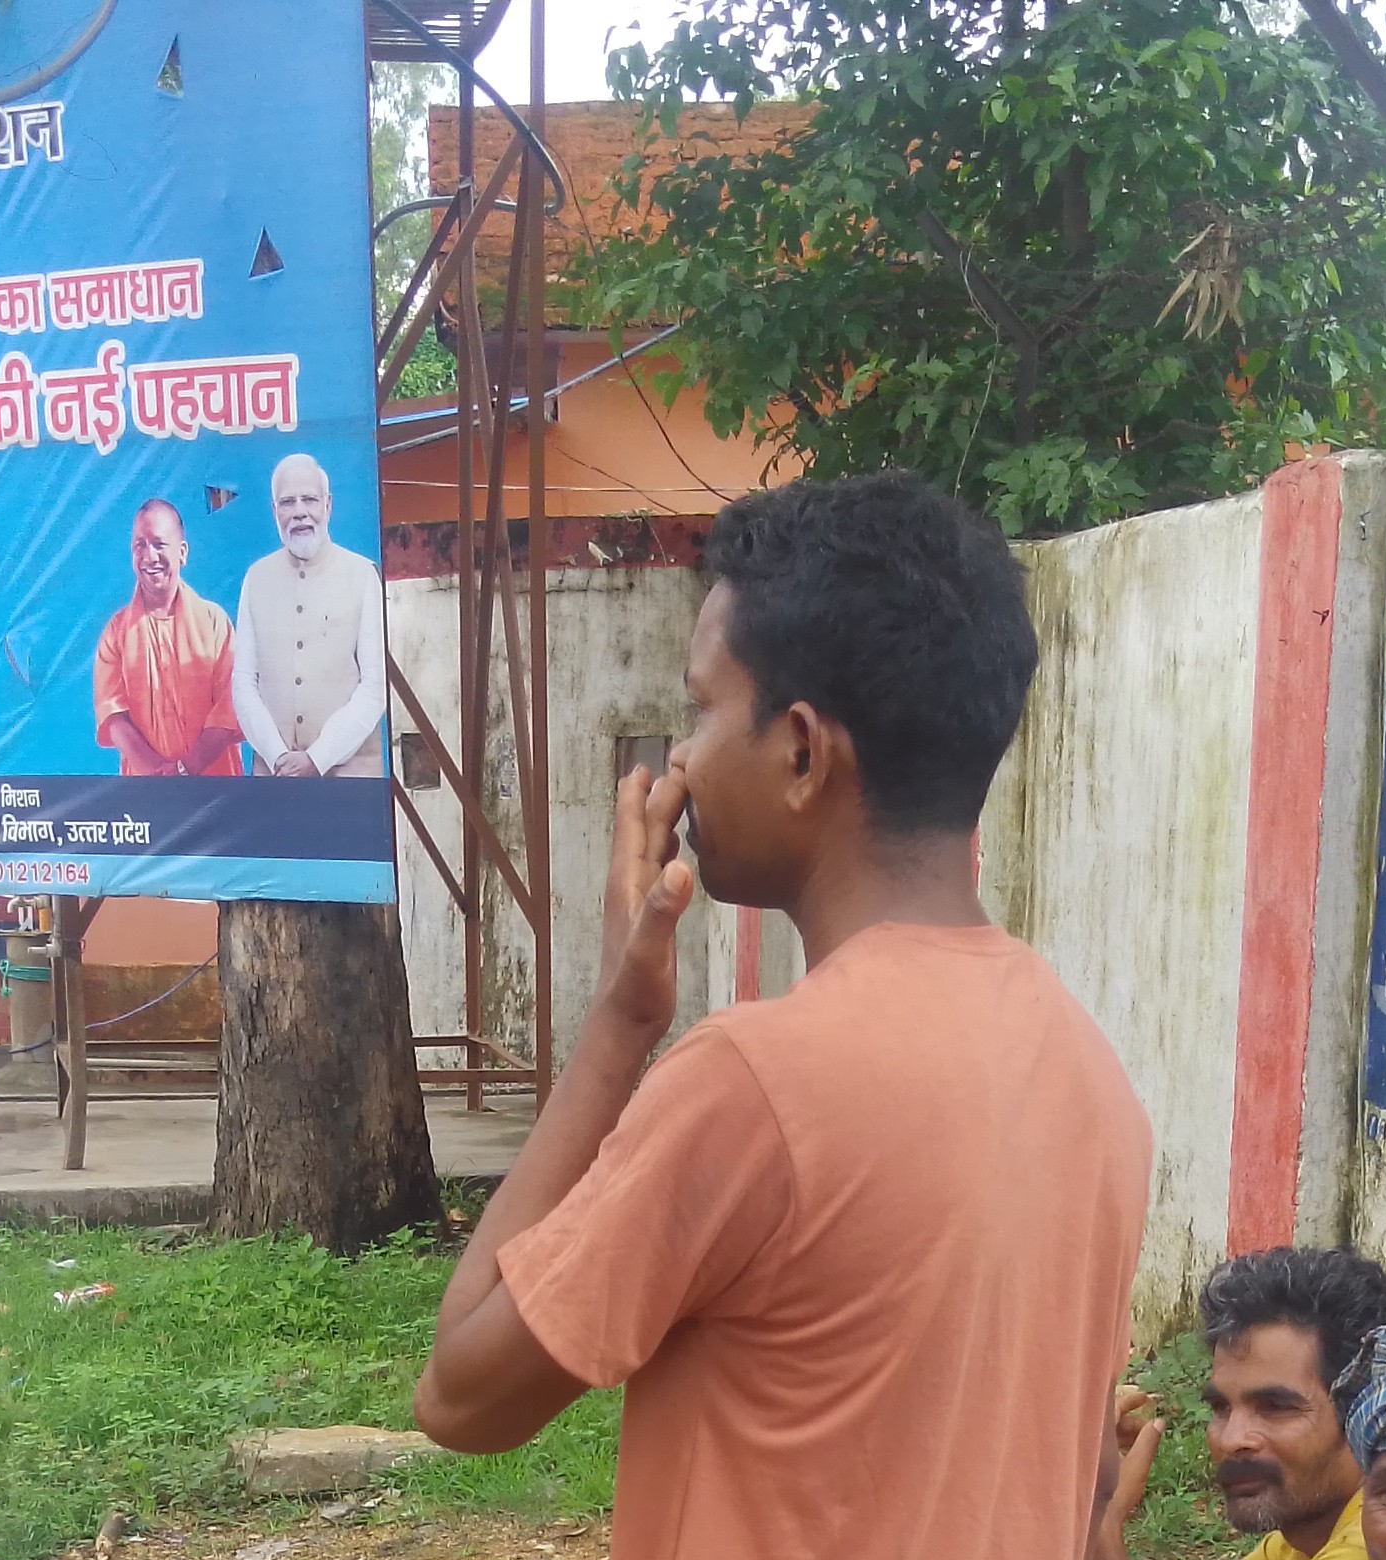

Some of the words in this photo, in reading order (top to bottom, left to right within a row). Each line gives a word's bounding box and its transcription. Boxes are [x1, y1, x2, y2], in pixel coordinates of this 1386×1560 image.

[48, 258, 204, 329] समाधान
[41, 340, 125, 455] नई
[130, 354, 298, 438] पहचान
[1, 783, 40, 808] मिशन
[2, 814, 62, 846] विभाग,
[64, 821, 108, 843] उत्तर
[112, 814, 150, 844] प्रदेश
